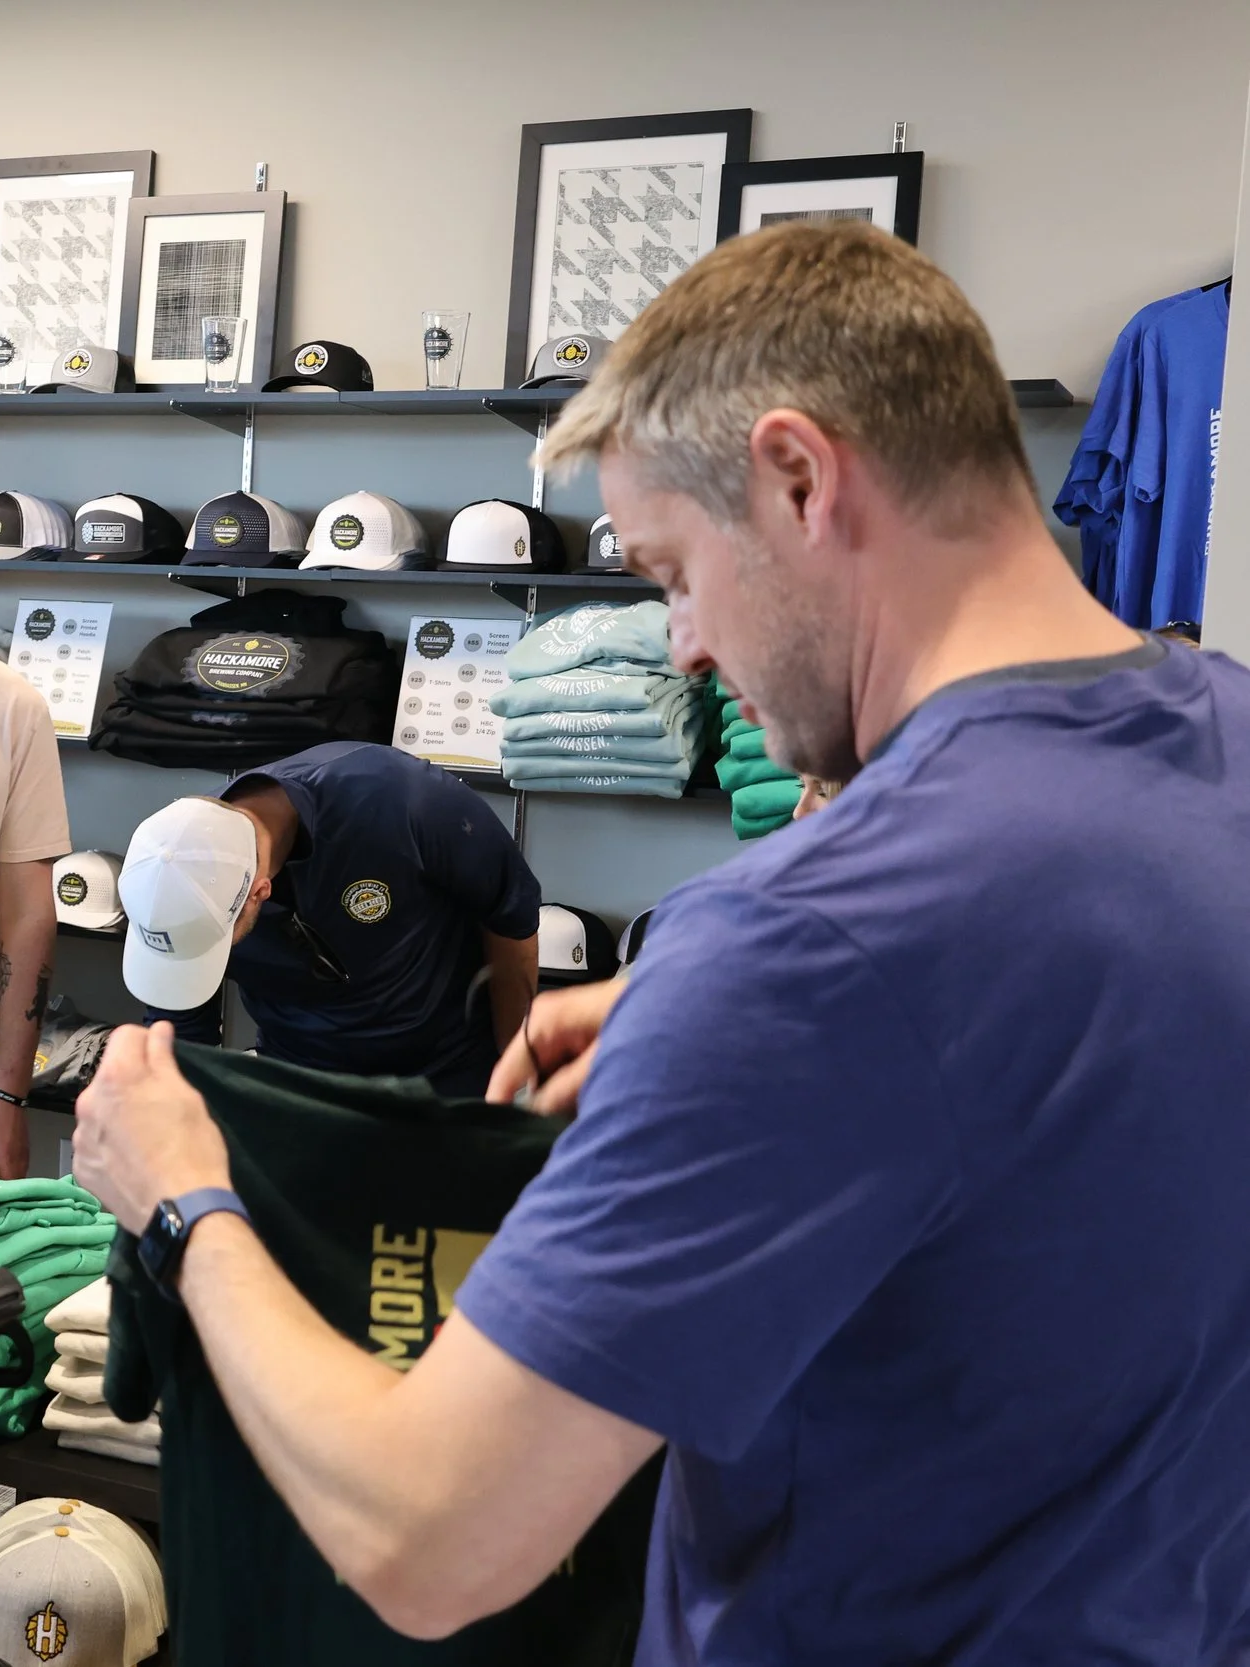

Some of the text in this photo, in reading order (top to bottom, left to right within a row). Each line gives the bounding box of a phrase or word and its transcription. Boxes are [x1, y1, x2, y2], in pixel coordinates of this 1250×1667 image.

[203, 653, 284, 670] HACKAMORE
[209, 668, 265, 679] BREWING COMPANY
